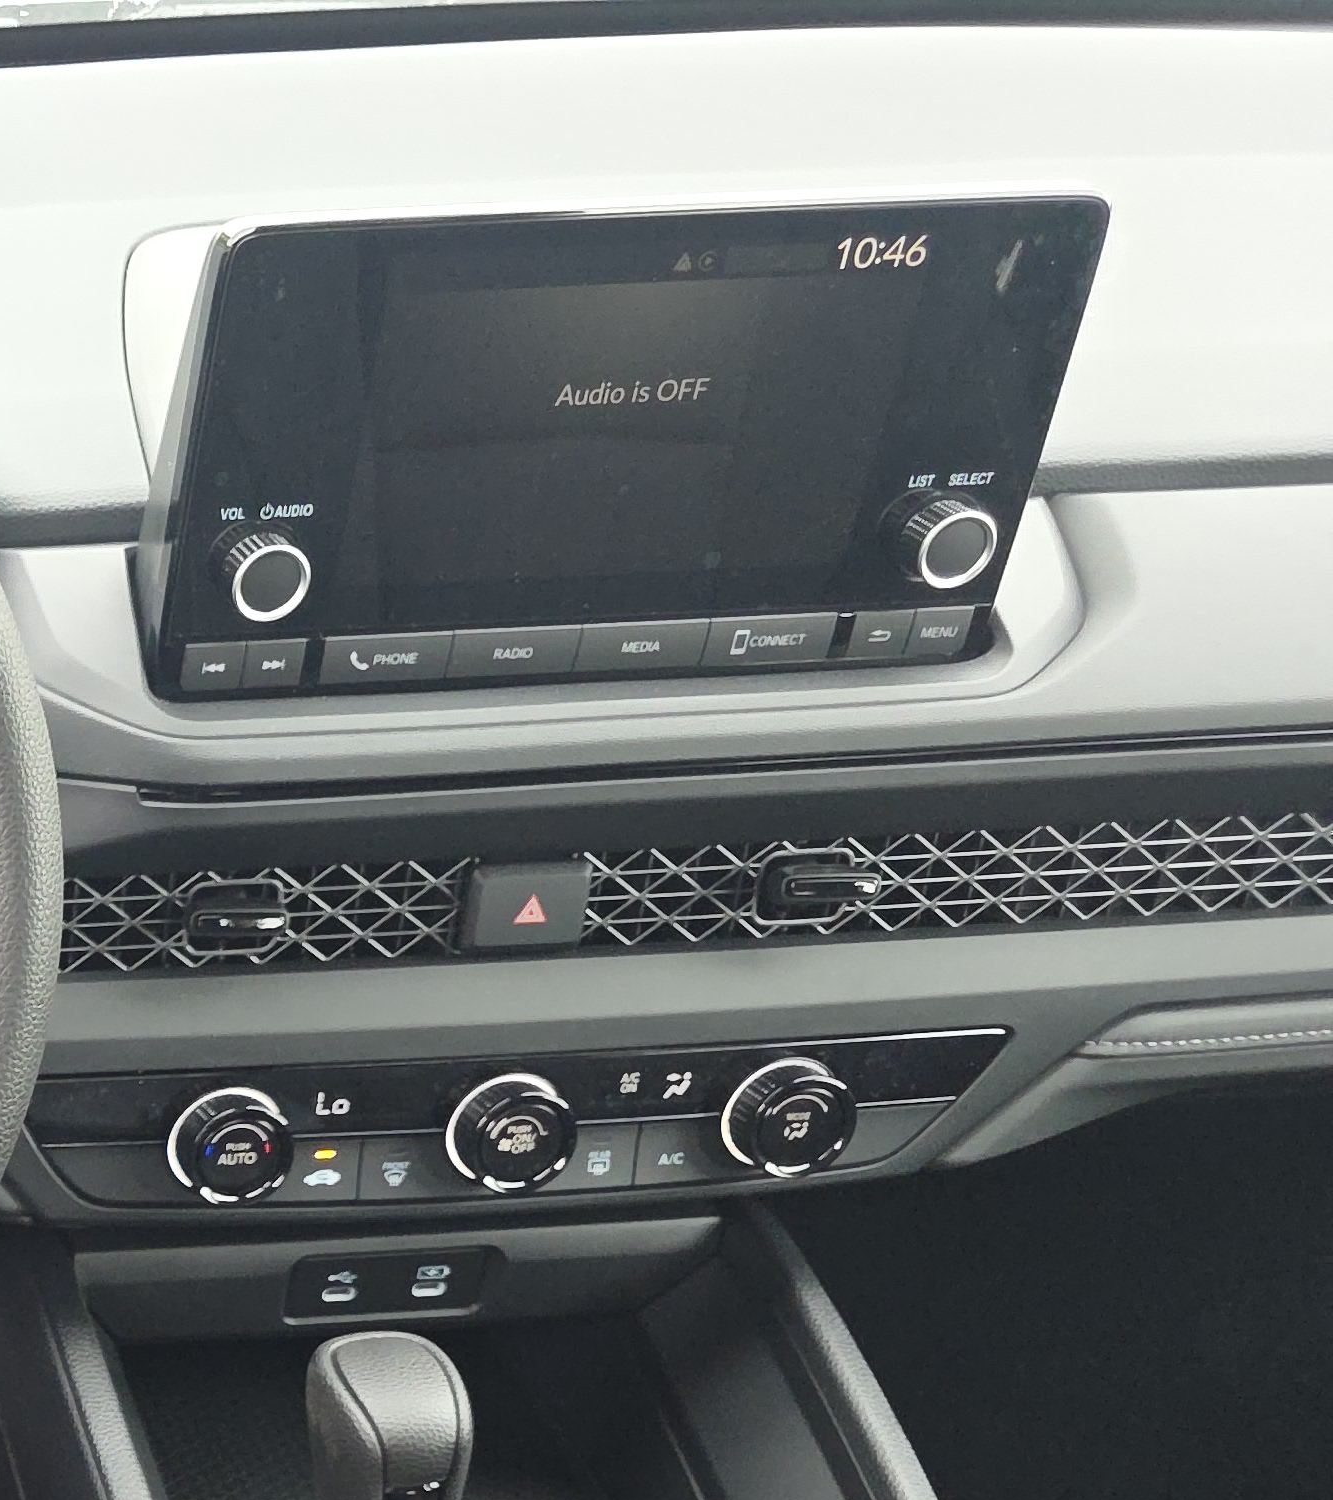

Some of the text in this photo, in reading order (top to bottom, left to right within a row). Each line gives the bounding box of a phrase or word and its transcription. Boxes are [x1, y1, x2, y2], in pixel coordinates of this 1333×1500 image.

[835, 234, 930, 272] 10:46
[554, 377, 711, 407] Audio is OFF
[908, 473, 936, 488] LIST
[948, 471, 995, 487] SELECT
[220, 506, 246, 521] VOL
[274, 502, 314, 519] AUDIO
[749, 633, 808, 649] CONNECT
[919, 625, 959, 641] MENU
[493, 645, 534, 660] RADIO
[621, 639, 661, 655] MEDIA
[372, 651, 419, 668] PHONE
[216, 1151, 259, 1167] AUTO
[657, 1151, 686, 1166] A/C
